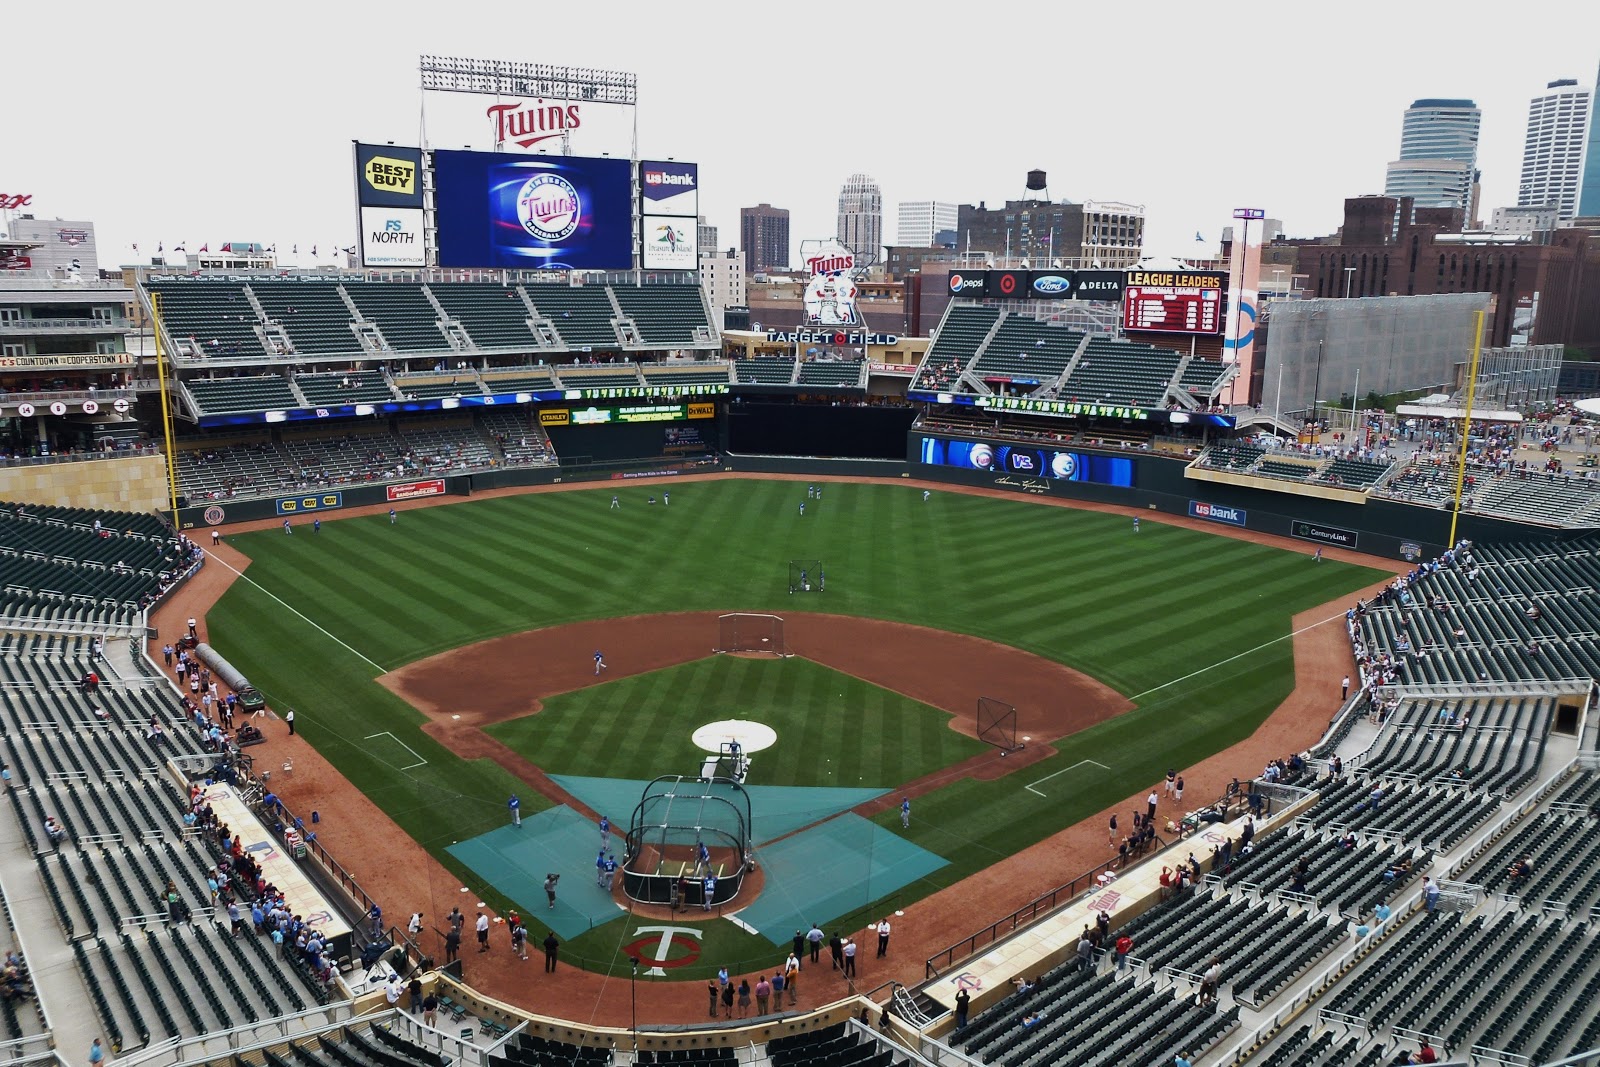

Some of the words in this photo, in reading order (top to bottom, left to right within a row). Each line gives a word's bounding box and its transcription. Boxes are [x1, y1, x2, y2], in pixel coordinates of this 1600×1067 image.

[487, 98, 581, 143] Twins
[372, 162, 413, 178] BEST
[373, 173, 410, 188] BUY
[521, 193, 577, 221] Twins
[385, 219, 402, 232] FS
[371, 231, 414, 244] NORTH
[807, 253, 853, 277] Twins
[963, 279, 984, 289] pepsi
[1040, 279, 1062, 291] Ford
[1088, 281, 1119, 290] DELTA
[1127, 271, 1174, 287] LEAGUE
[1175, 274, 1220, 288] LEADERS
[767, 332, 833, 344] TARGET
[849, 335, 899, 345] FIELD
[16, 356, 59, 366] COUNTDOWN
[67, 355, 117, 365] COOPERSTOWN
[1310, 528, 1347, 541] CenturyLink
